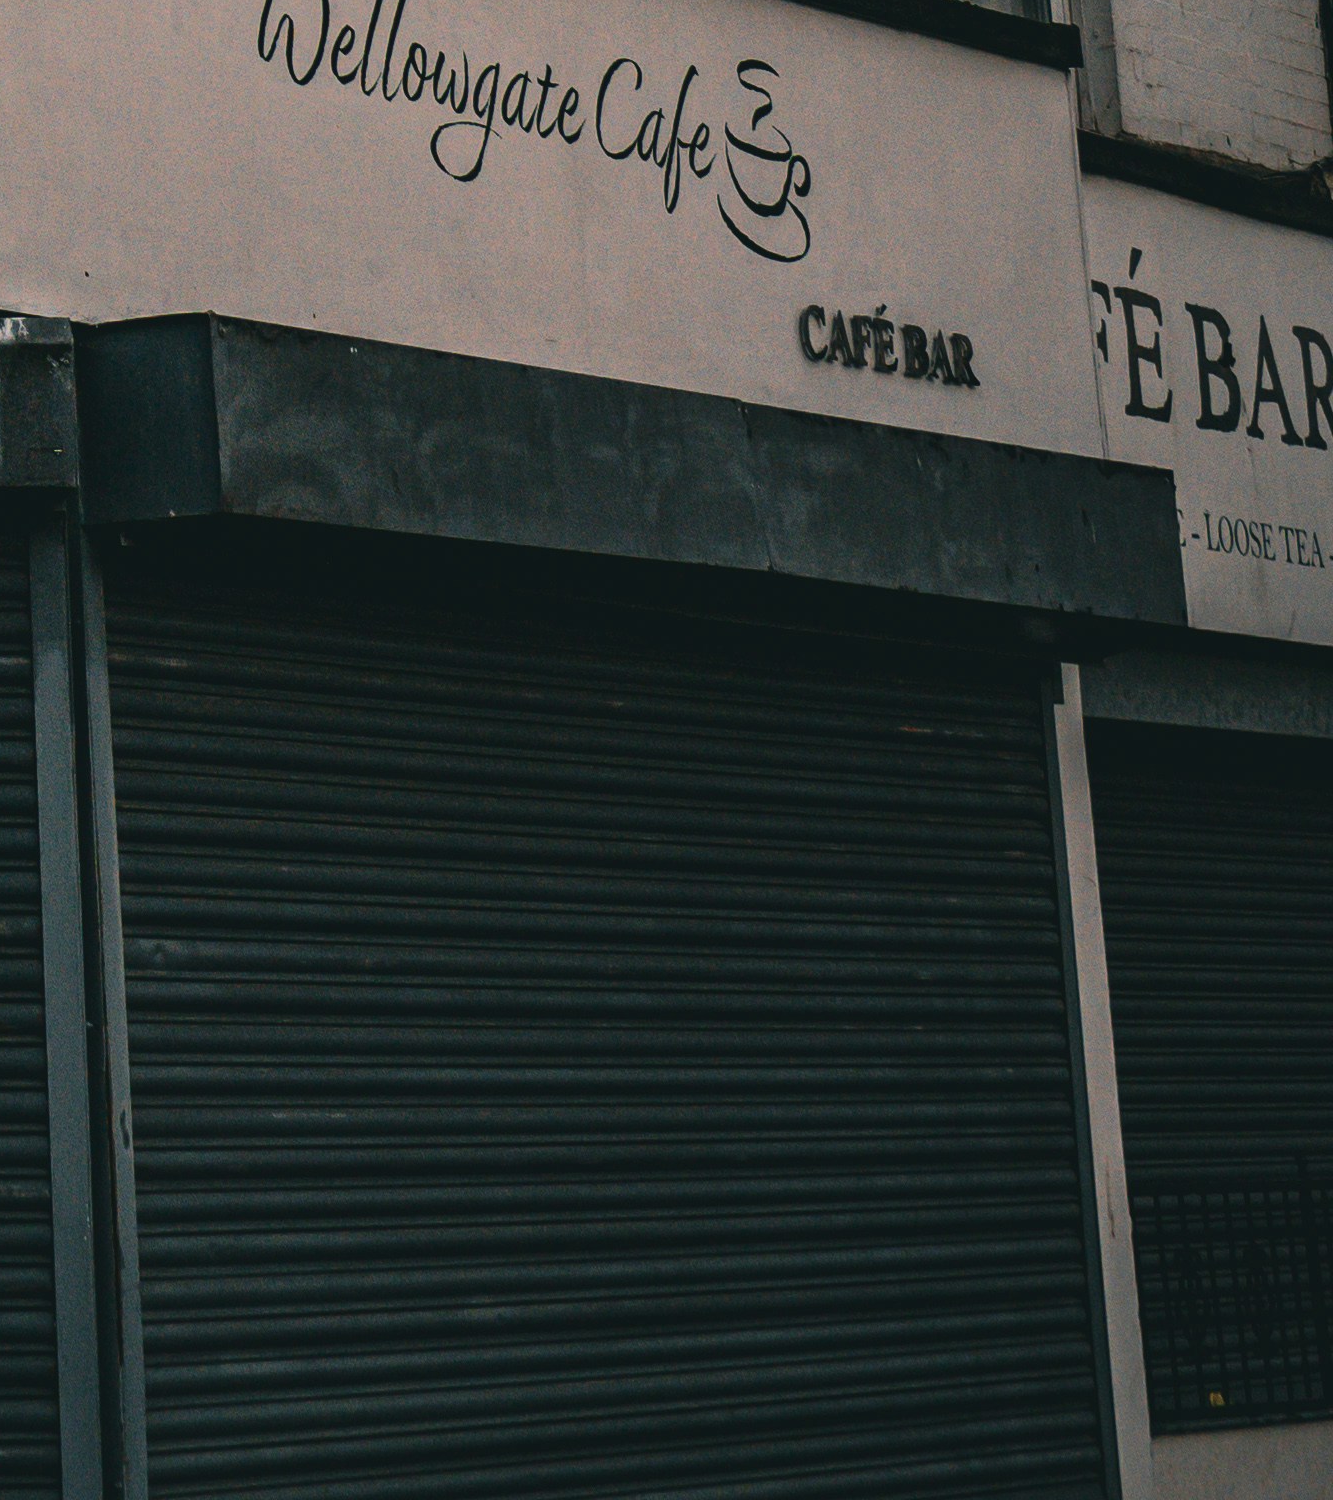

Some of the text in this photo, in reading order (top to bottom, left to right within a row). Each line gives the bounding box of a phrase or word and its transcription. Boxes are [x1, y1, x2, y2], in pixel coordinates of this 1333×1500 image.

[595, 57, 717, 214] Cafe
[797, 304, 981, 390] CAFÉ BAR
[1184, 301, 1333, 451] BAR
[1203, 511, 1276, 562] LOOSE
[1278, 525, 1326, 569] TEA
